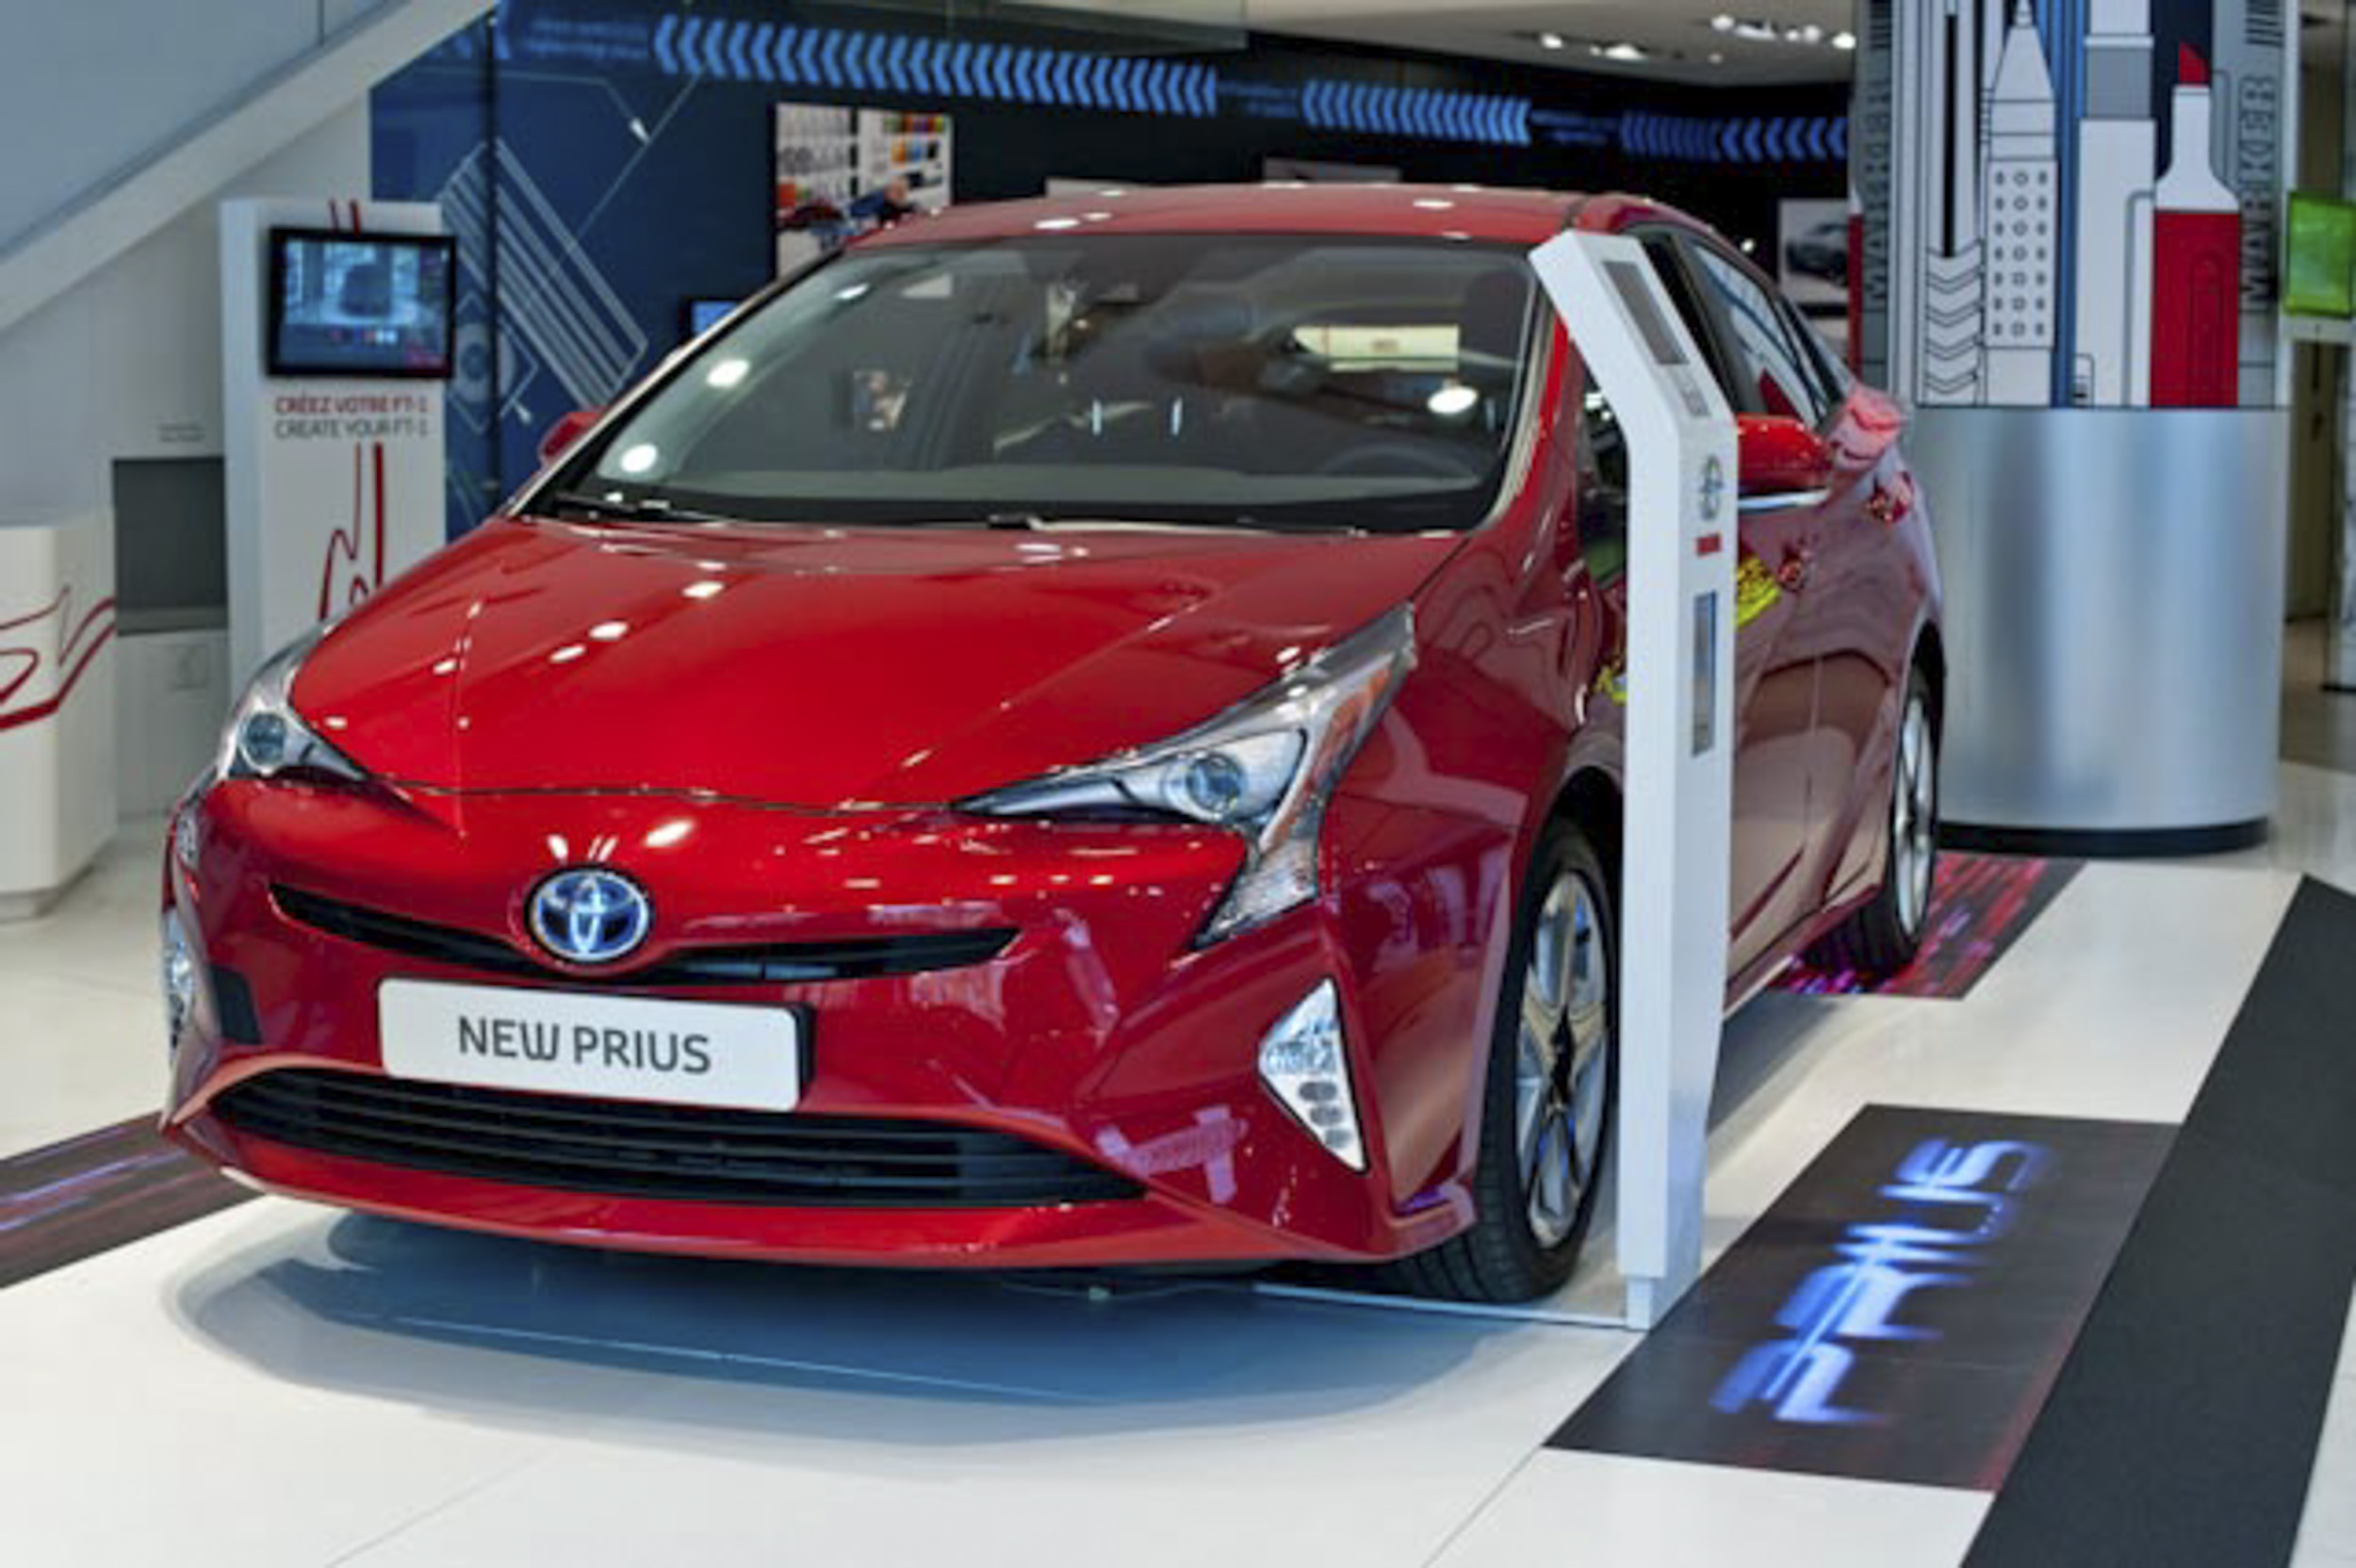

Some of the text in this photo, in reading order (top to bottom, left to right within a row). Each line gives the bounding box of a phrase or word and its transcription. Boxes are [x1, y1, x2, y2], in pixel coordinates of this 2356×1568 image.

[2238, 74, 2276, 309] MARKER
[276, 393, 429, 414] CRÉEZ VOTRE FT-1
[276, 419, 429, 439] CREATE YOUR FT-1
[459, 1016, 712, 1074] NEW PRIUS
[1710, 1138, 2053, 1425] PRIUS
